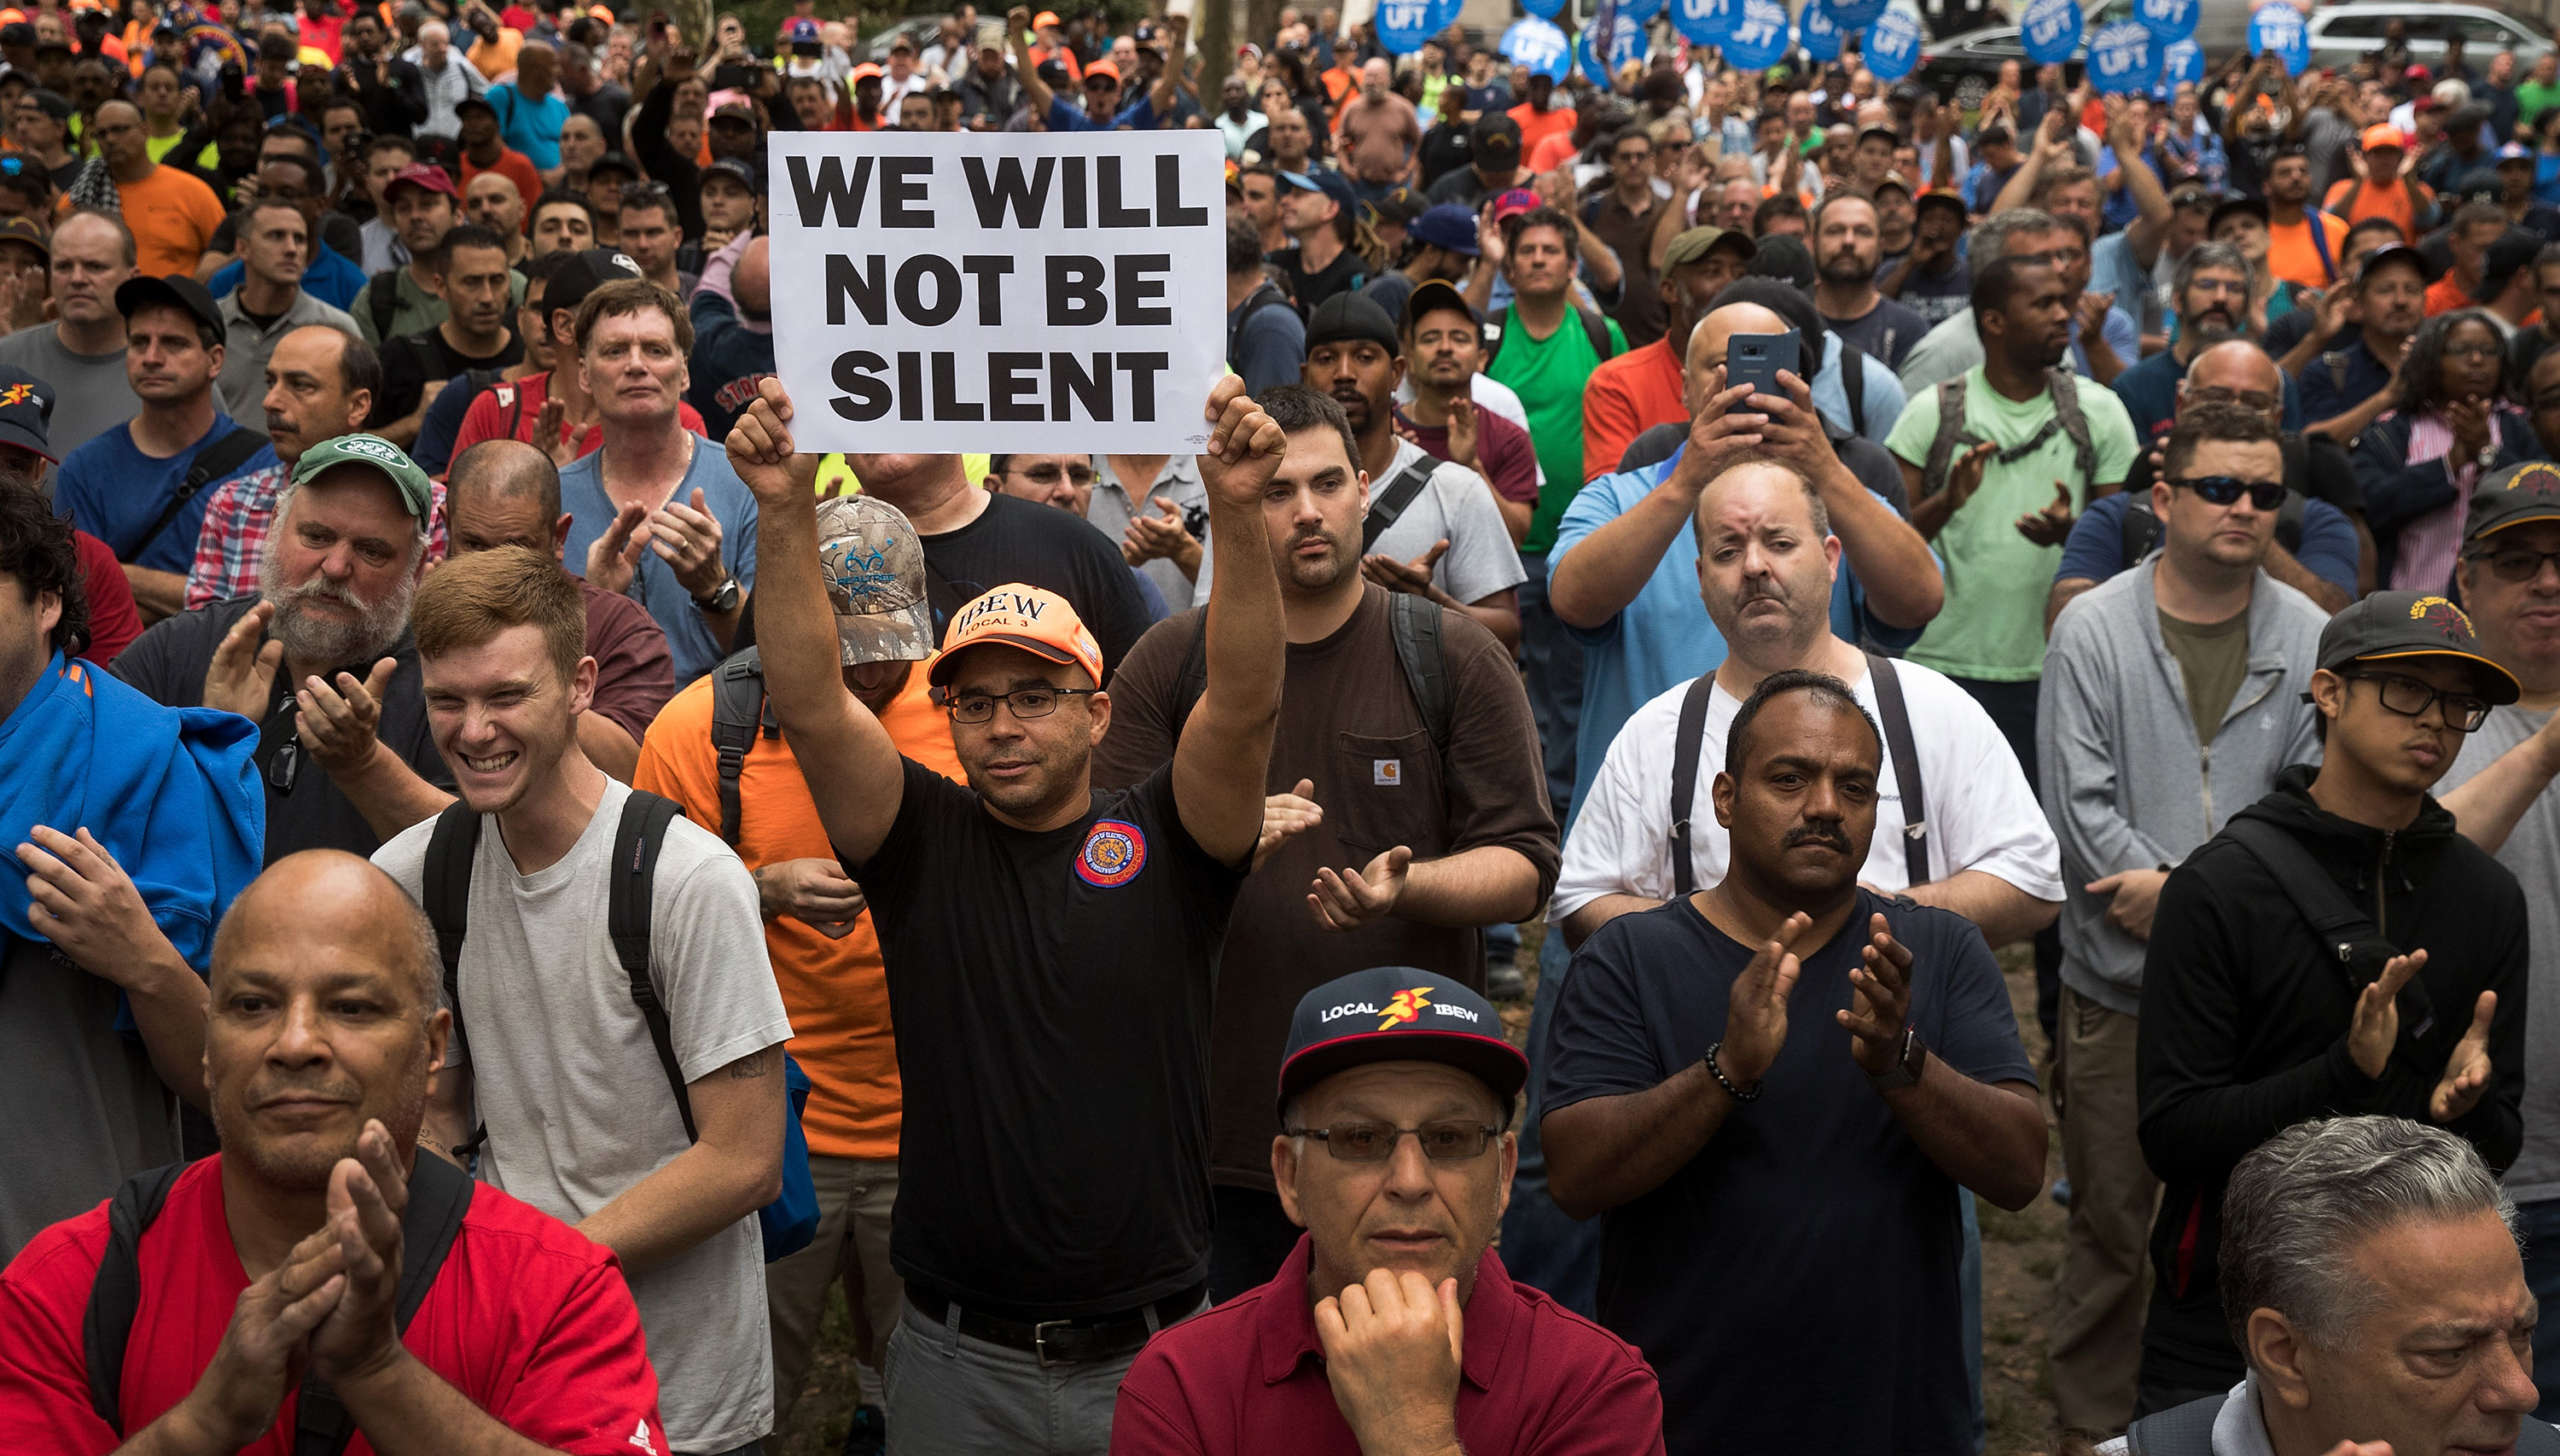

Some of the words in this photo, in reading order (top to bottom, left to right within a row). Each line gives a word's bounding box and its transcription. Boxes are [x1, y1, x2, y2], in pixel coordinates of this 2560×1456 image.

[1385, 5, 1427, 30] UFT
[2031, 8, 2072, 46] UFT
[1514, 39, 1559, 69] UFT
[1872, 29, 1911, 60] UFT
[2098, 45, 2149, 76] UFT
[785, 156, 936, 229] WE
[960, 154, 1209, 229] WILL
[825, 253, 1015, 327] NOT
[1044, 253, 1173, 327] BE
[828, 350, 1169, 422] SILENT
[837, 572, 897, 585] REALTREE
[957, 592, 1047, 636] IBEW
[965, 617, 1012, 636] LOCAL
[1020, 619, 1029, 628] 3
[1321, 1002, 1379, 1023] LOCAL
[1433, 1003, 1479, 1024] IBEW
